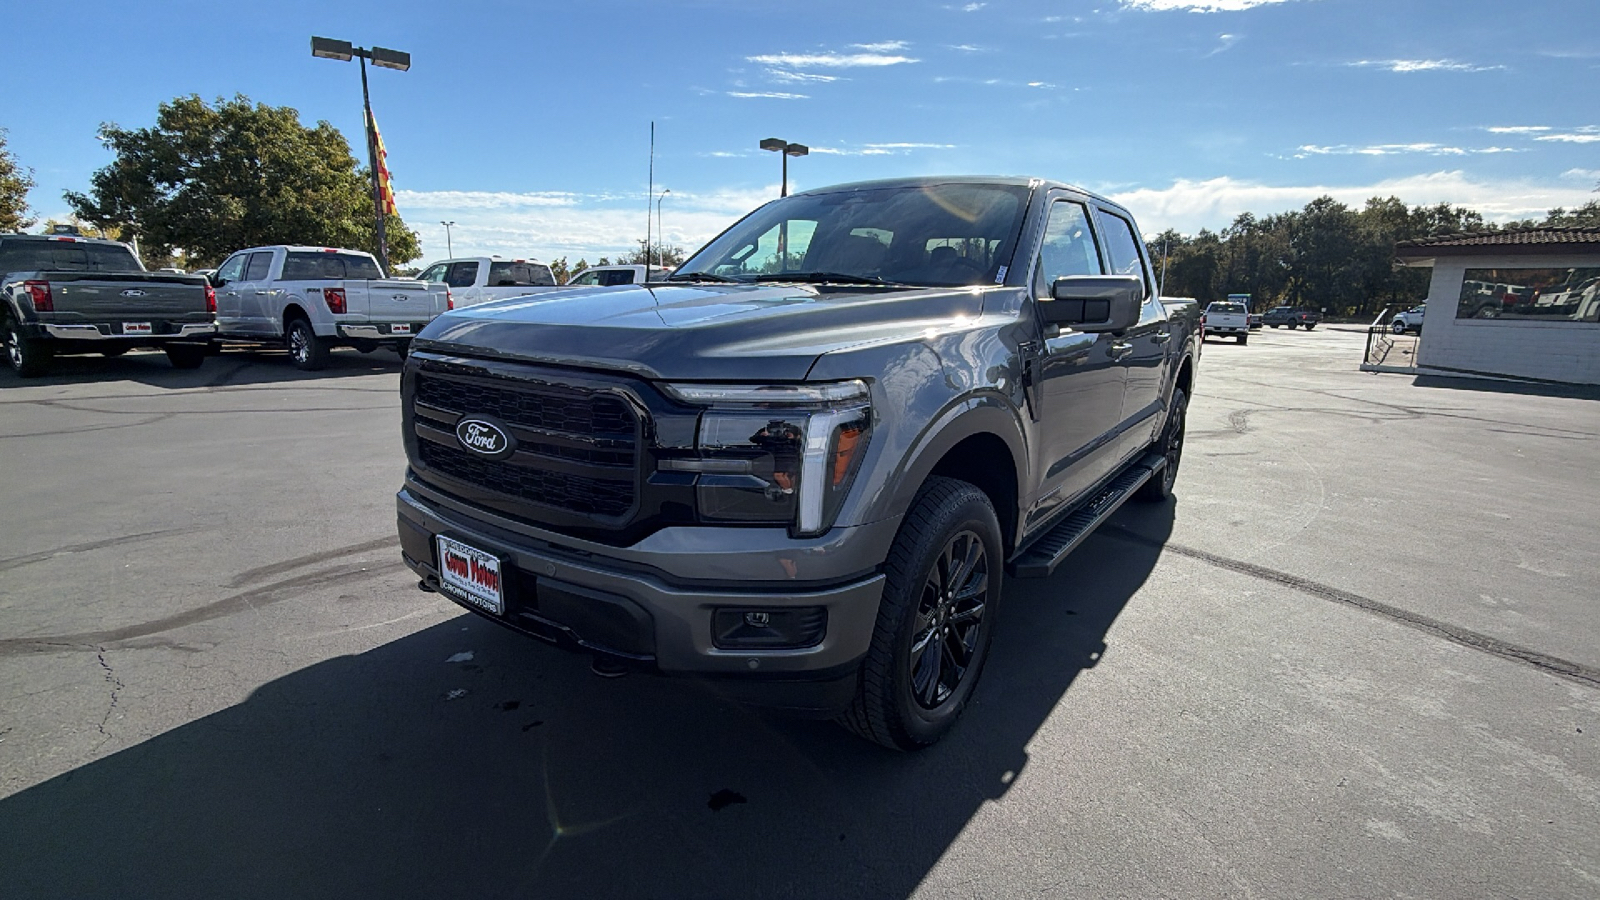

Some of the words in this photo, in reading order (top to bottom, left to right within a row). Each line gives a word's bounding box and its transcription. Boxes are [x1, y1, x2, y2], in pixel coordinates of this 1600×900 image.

[465, 423, 497, 450] Ford
[443, 582, 467, 599] CROWN
[468, 593, 497, 613] MOTORS
